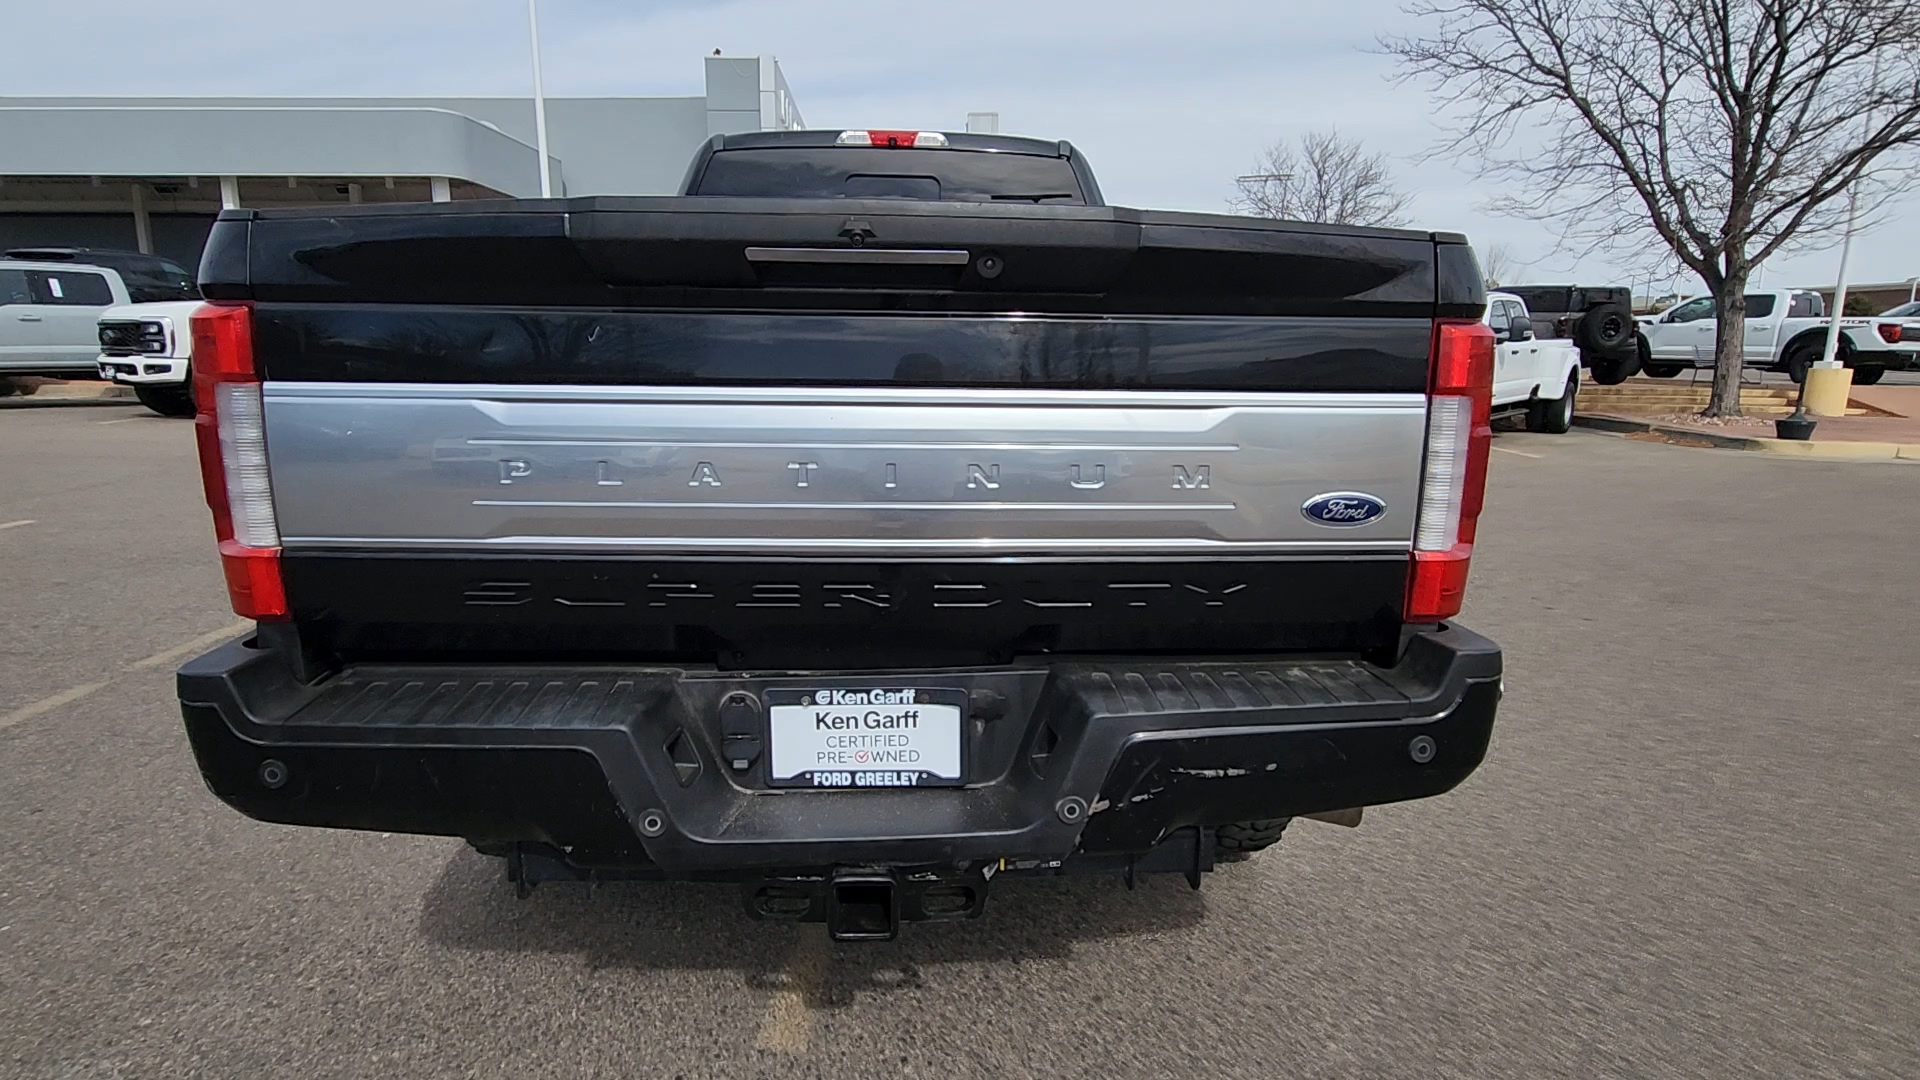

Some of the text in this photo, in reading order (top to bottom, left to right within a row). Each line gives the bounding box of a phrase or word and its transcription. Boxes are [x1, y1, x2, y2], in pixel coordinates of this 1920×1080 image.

[499, 459, 1210, 489] PLATINUM
[1322, 499, 1369, 519] Ford
[832, 689, 916, 705] Ken Garff
[815, 711, 919, 731] Ken Garff
[826, 735, 909, 749] CERTIFIED
[817, 750, 920, 764] PRE-OWNED
[813, 772, 919, 786] FORD GREELEY
